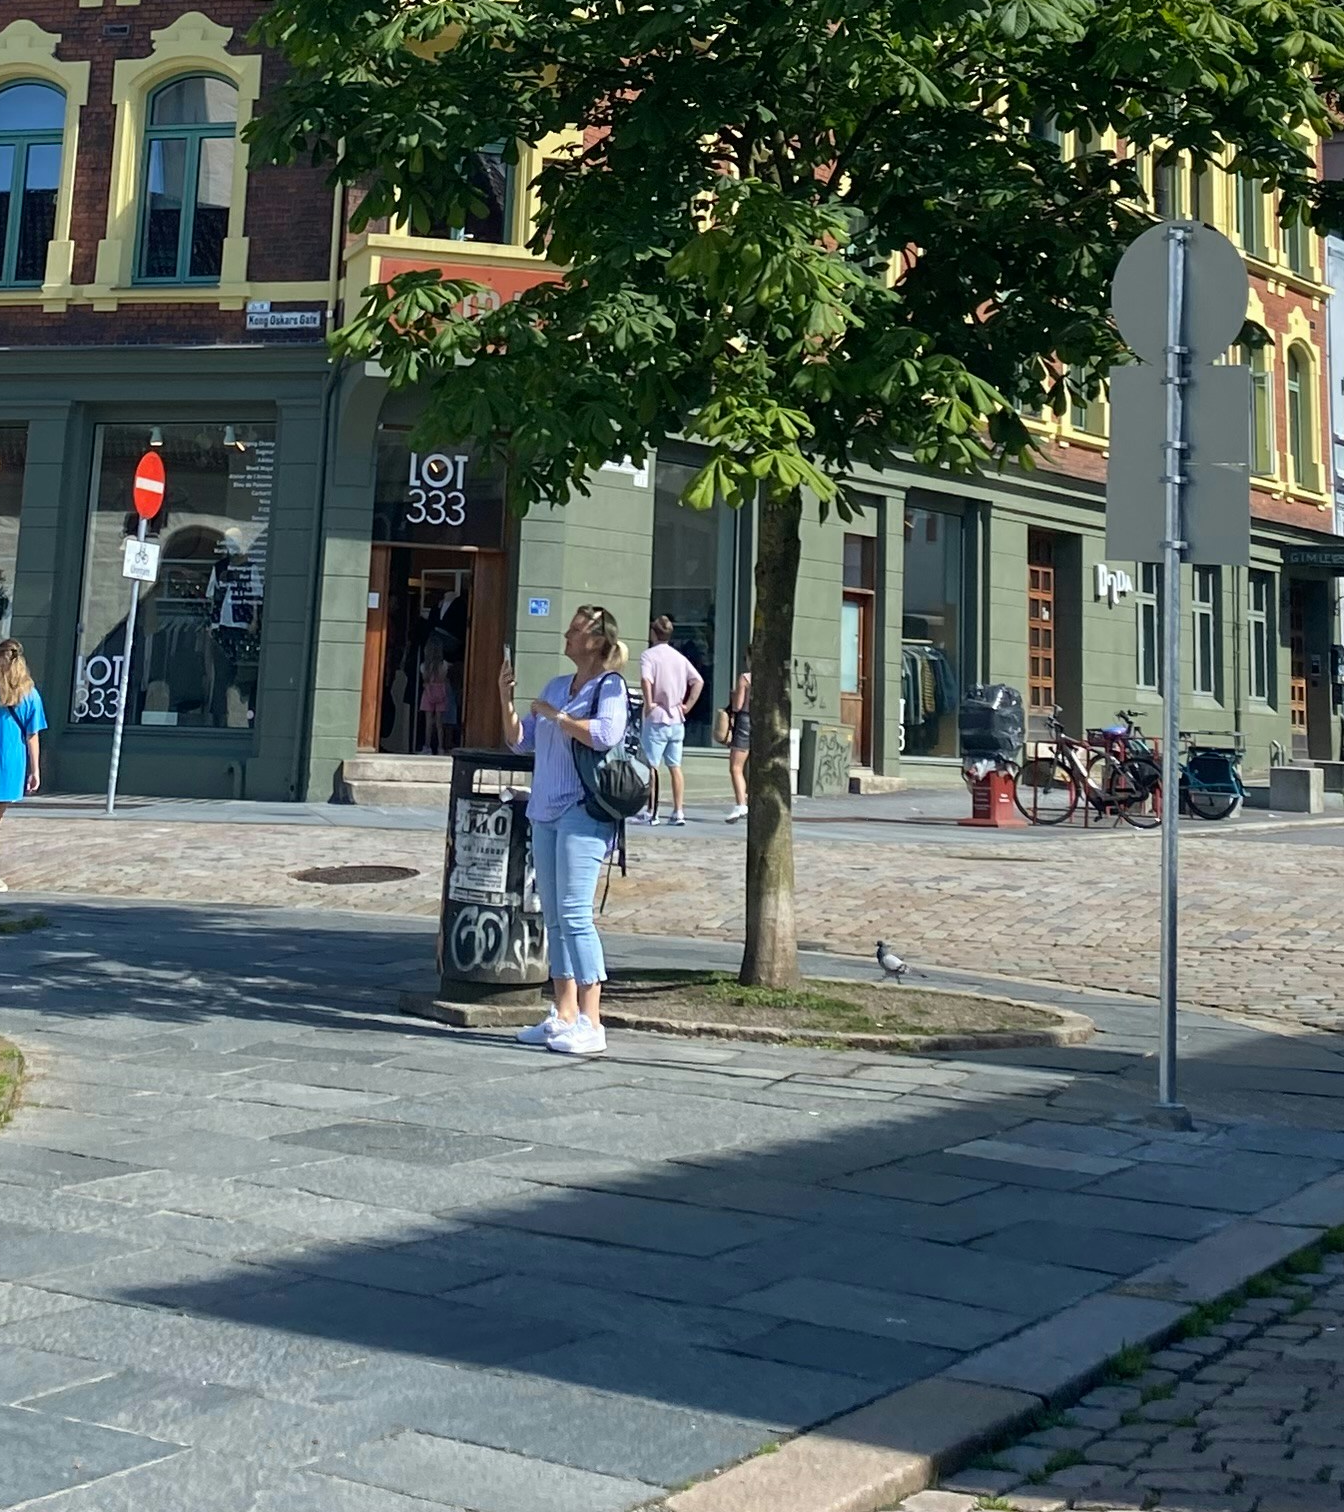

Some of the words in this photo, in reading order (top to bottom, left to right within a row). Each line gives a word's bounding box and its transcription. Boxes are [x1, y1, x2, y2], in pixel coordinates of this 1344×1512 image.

[409, 452, 468, 489] LOT
[406, 489, 465, 526] 333
[77, 655, 124, 686] LOT
[74, 688, 121, 719] 333
